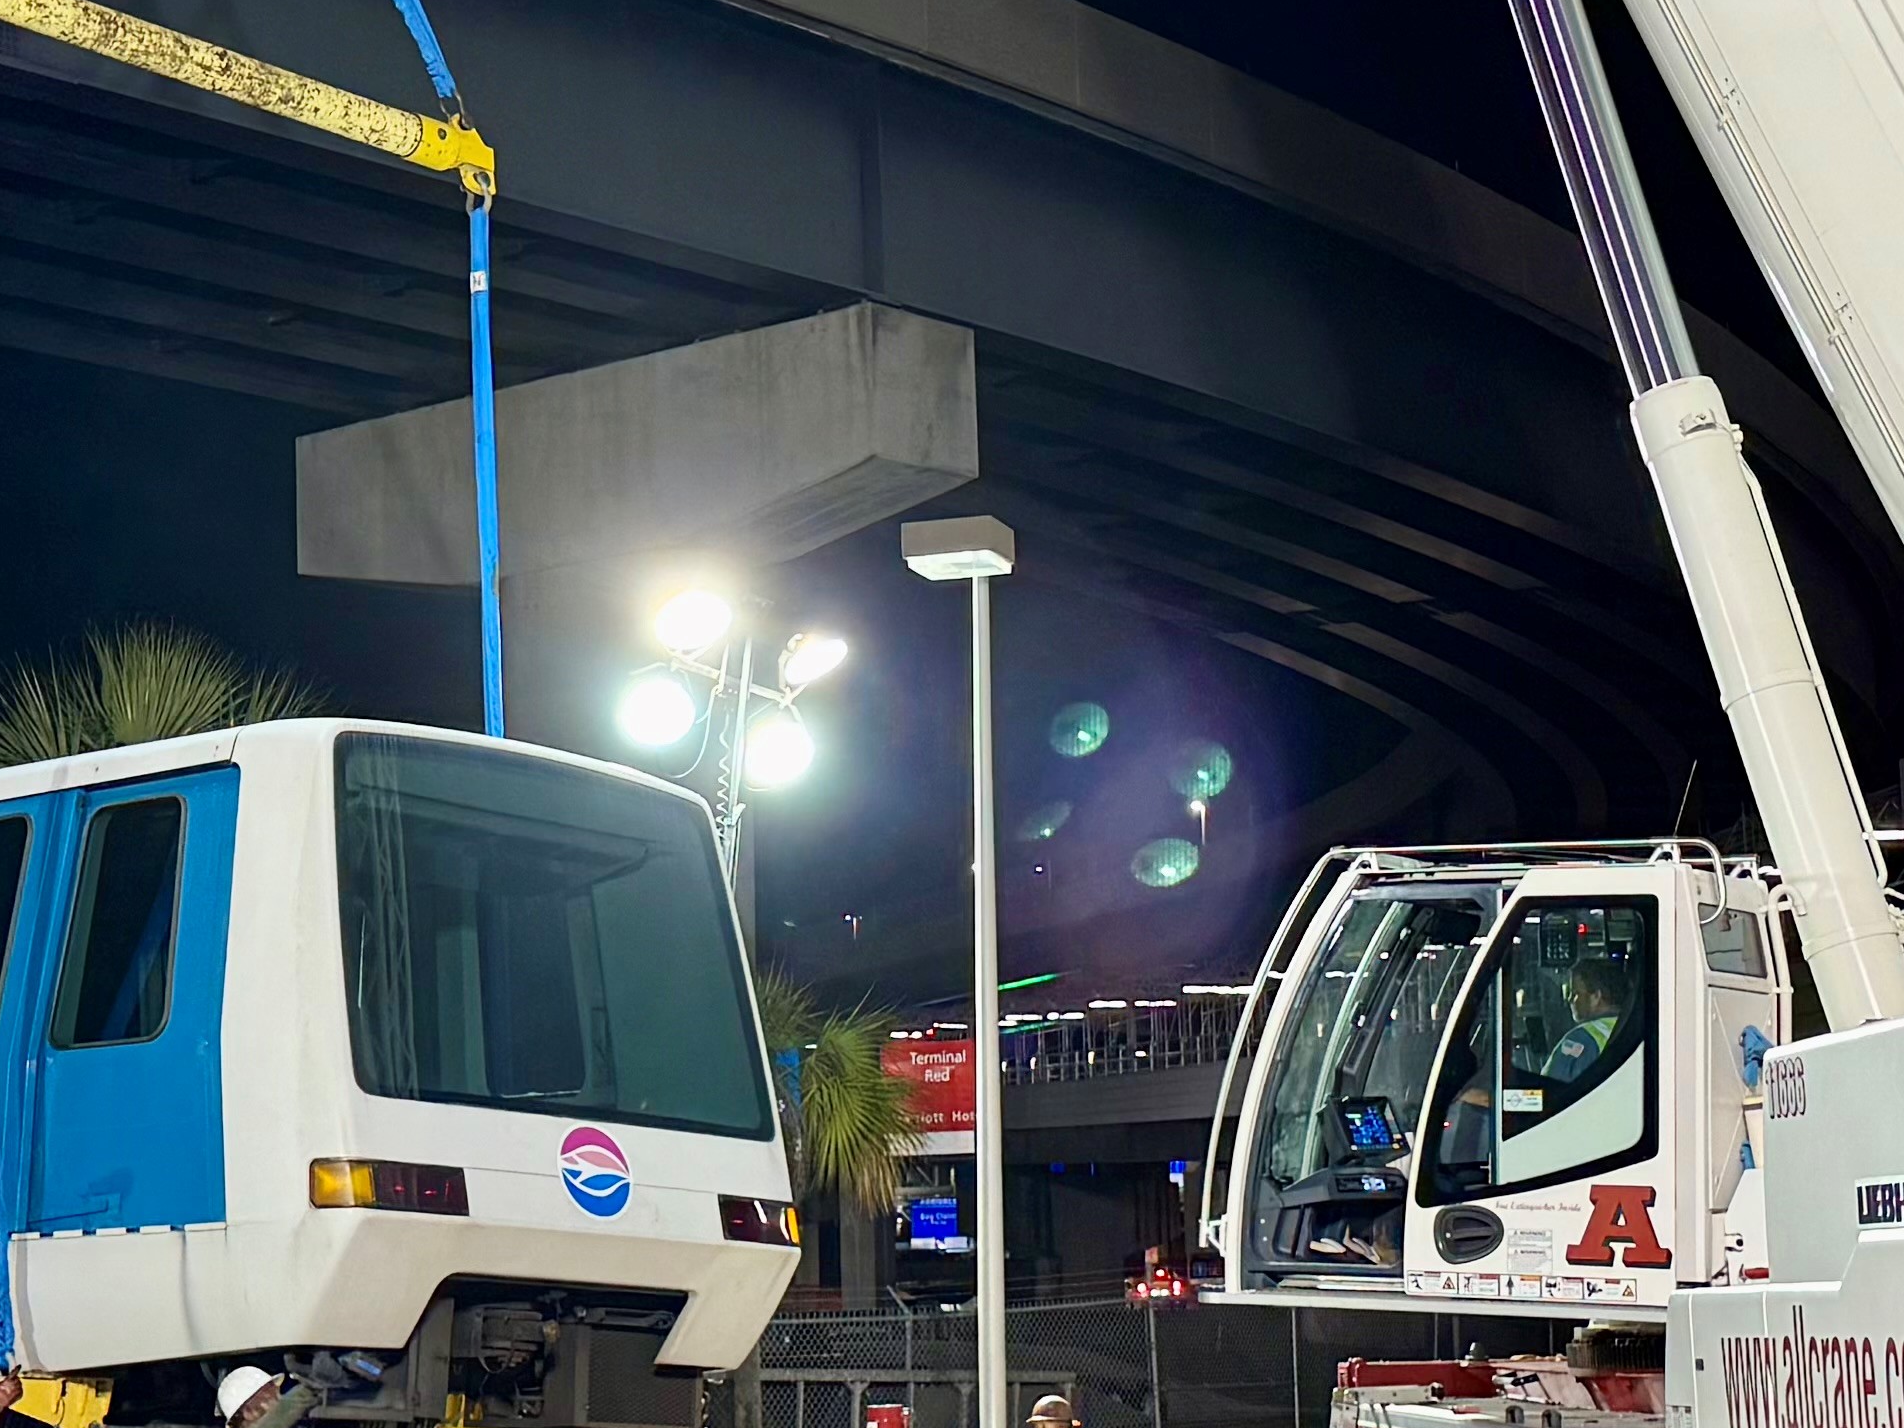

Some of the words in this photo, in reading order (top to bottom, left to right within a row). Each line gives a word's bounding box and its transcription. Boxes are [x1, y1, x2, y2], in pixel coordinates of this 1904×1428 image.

[909, 1049, 966, 1065] Terminal
[925, 1066, 951, 1082] Red
[1566, 1184, 1673, 1269] A
